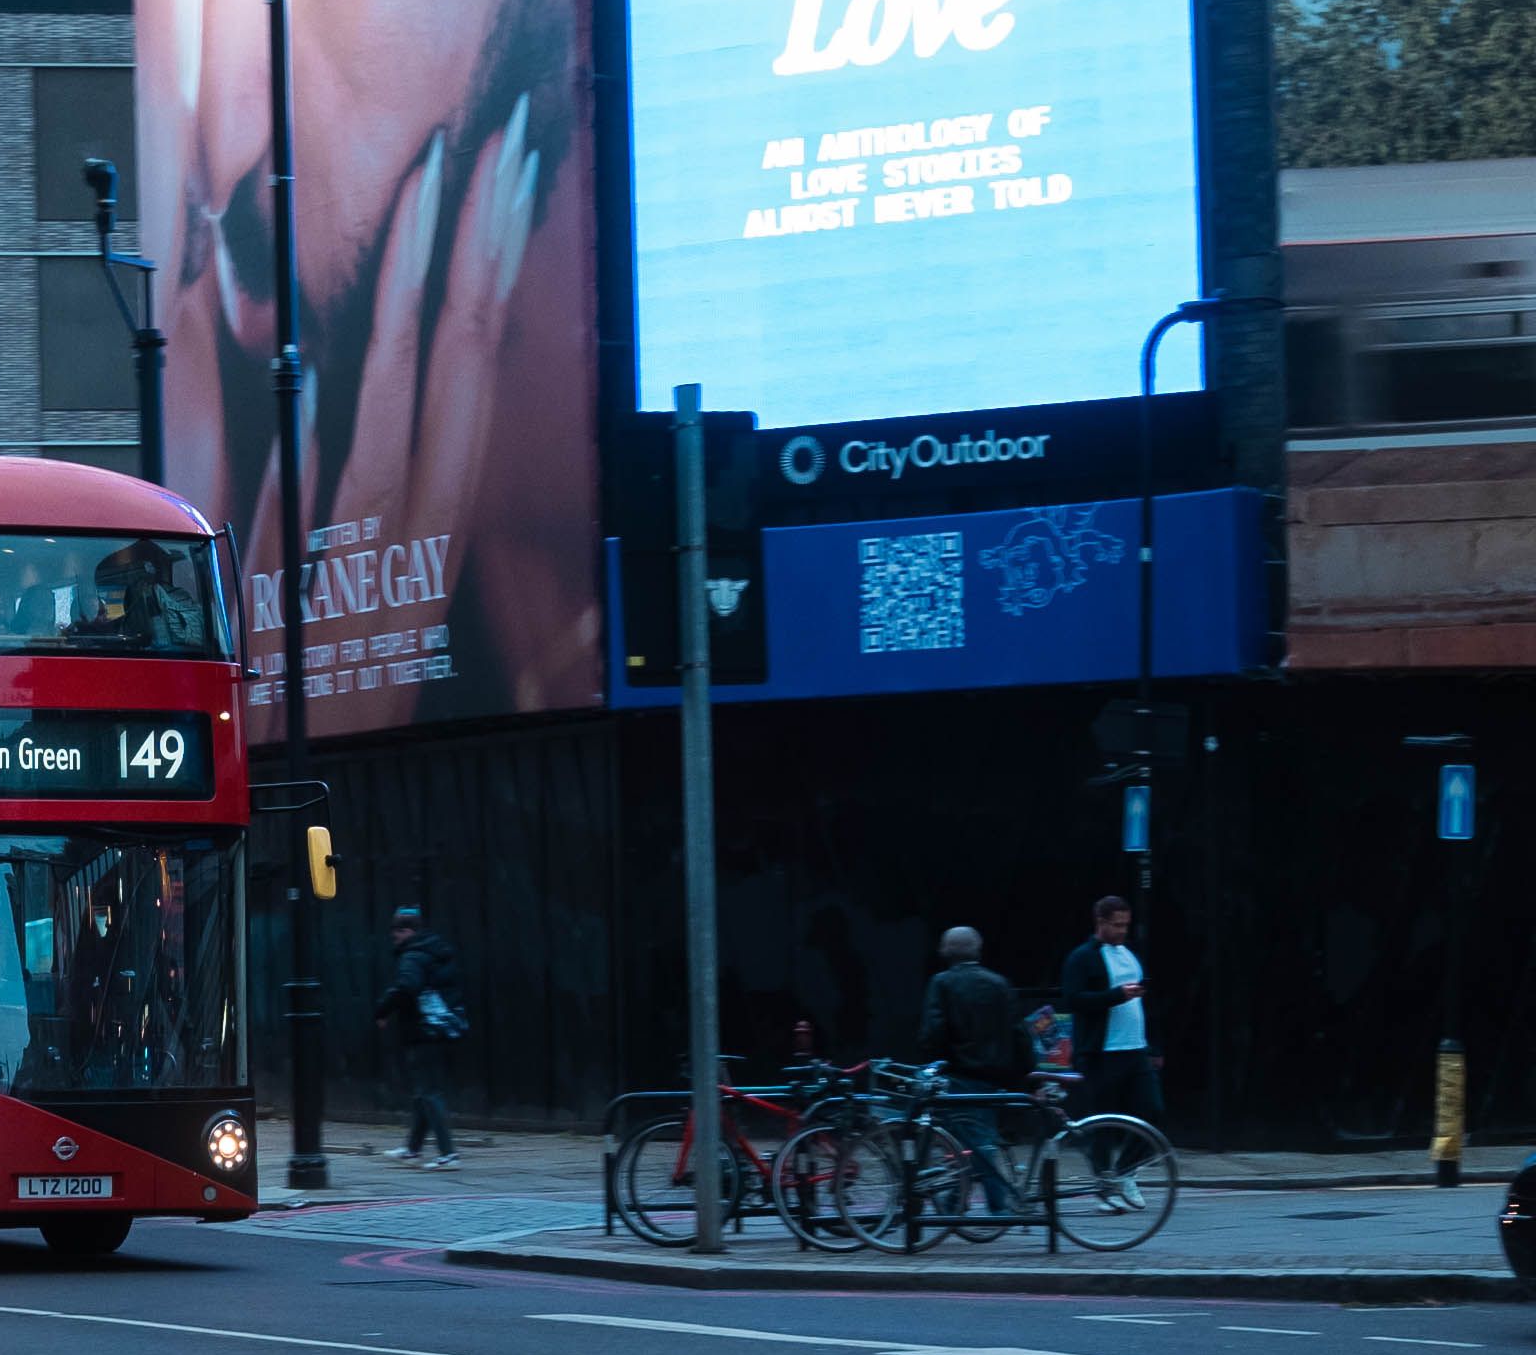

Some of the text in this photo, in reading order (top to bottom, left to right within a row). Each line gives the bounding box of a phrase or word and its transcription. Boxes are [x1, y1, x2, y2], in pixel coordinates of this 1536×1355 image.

[762, 106, 1051, 168] AN ANTHOLOGY OF
[791, 145, 1022, 199] LOVE STORIES
[743, 174, 1072, 238] ALMOST NEVER TOLD
[840, 430, 1050, 479] CityOutdoor
[381, 534, 451, 608] GAY
[18, 737, 81, 771] Green
[119, 729, 185, 779] 149
[28, 1178, 102, 1195] LTZ 1200
